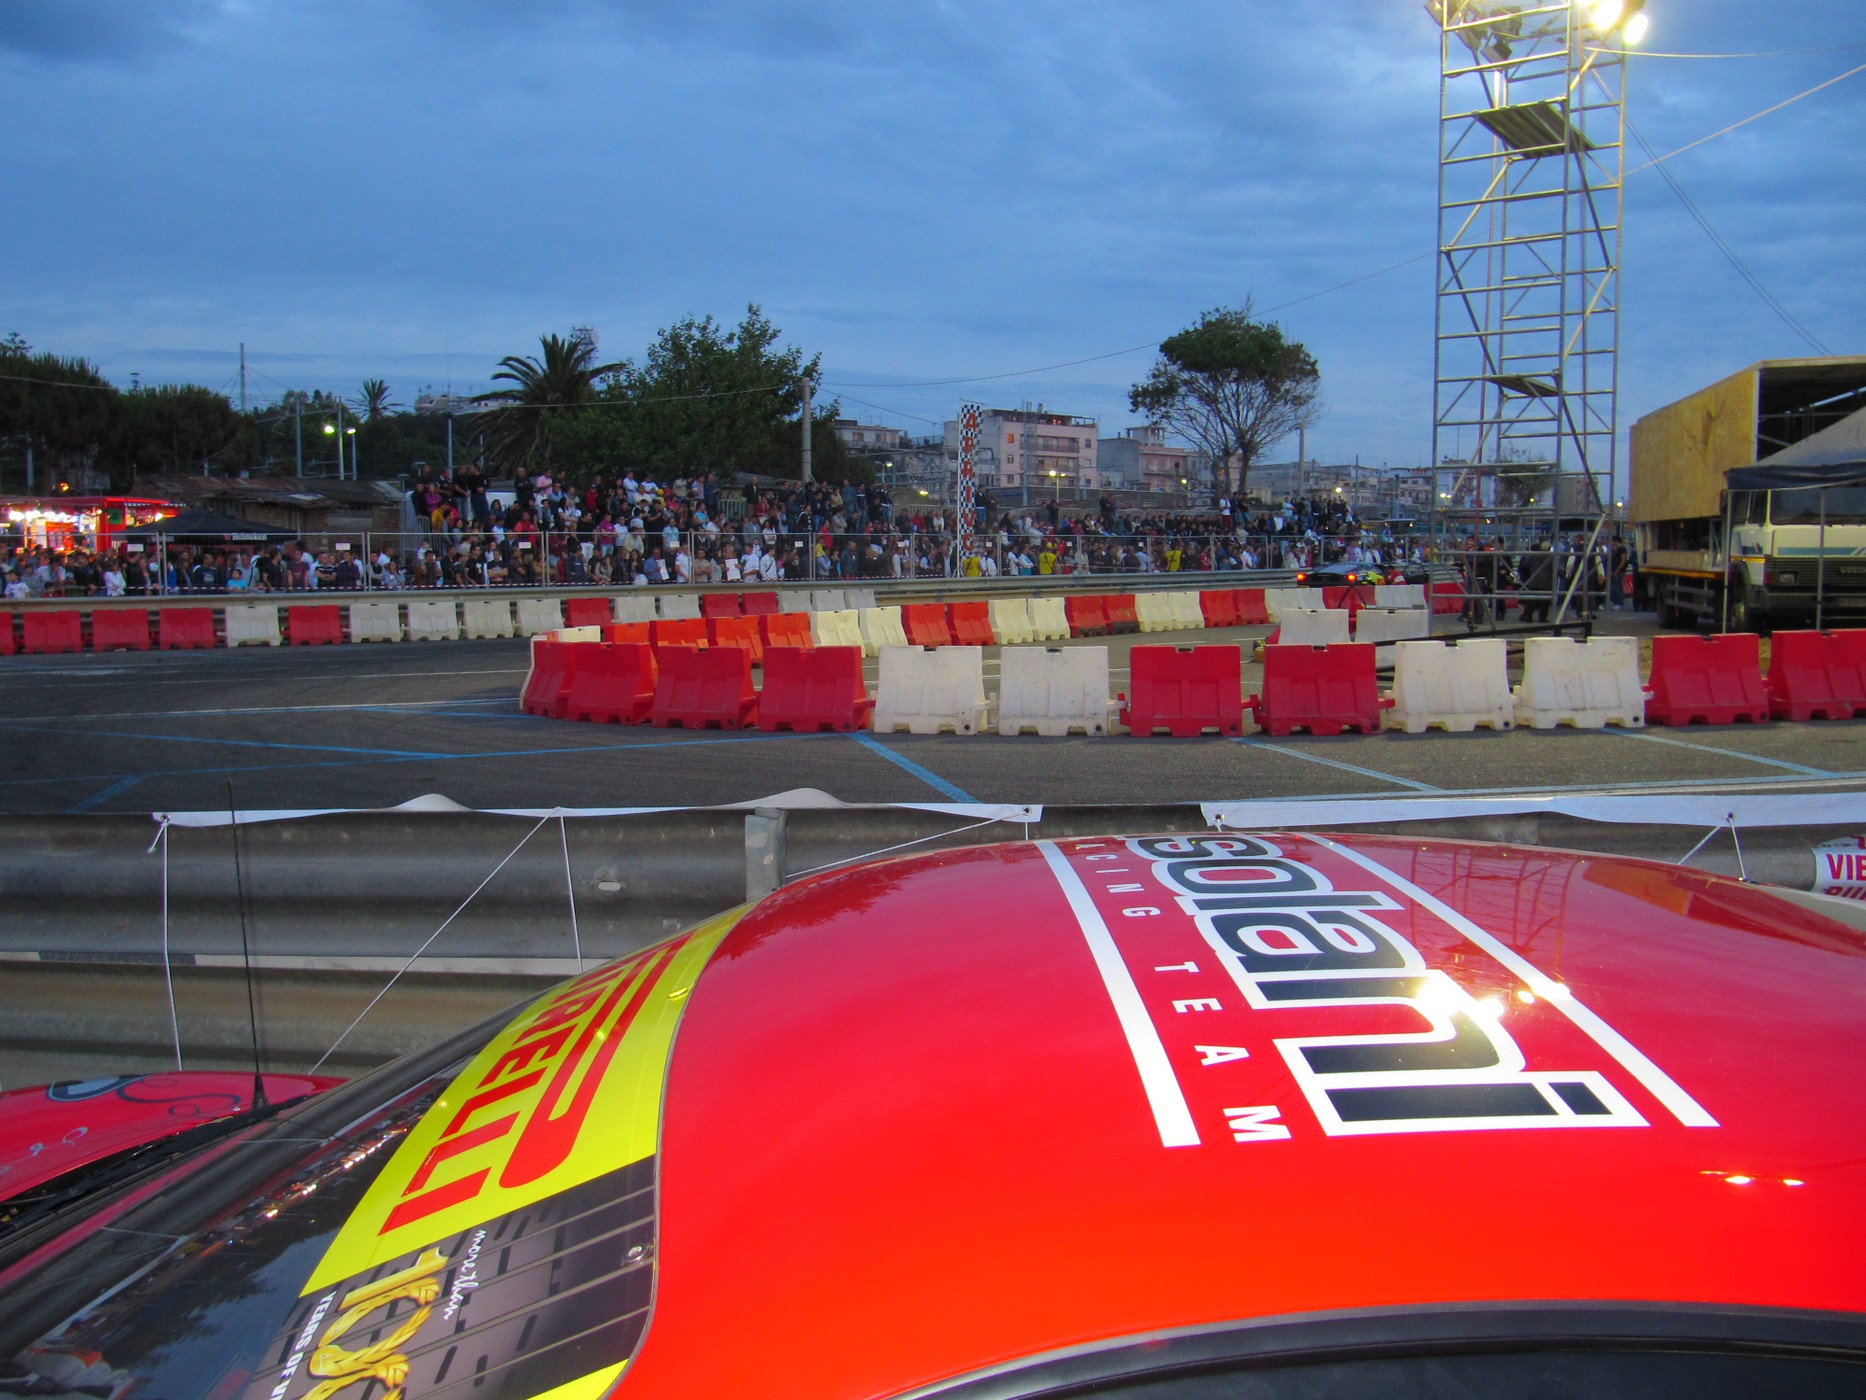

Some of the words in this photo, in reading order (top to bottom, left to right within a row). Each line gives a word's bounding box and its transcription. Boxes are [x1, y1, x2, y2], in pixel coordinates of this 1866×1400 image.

[1067, 837, 1161, 917] ACING
[1155, 960, 1292, 1143] TEAM
[1122, 834, 1651, 1136] solani
[377, 931, 699, 1236] PIRELLI
[461, 1229, 487, 1273] more
[296, 1290, 337, 1350] YEARS
[443, 1270, 479, 1320] than
[281, 1351, 304, 1378] OF
